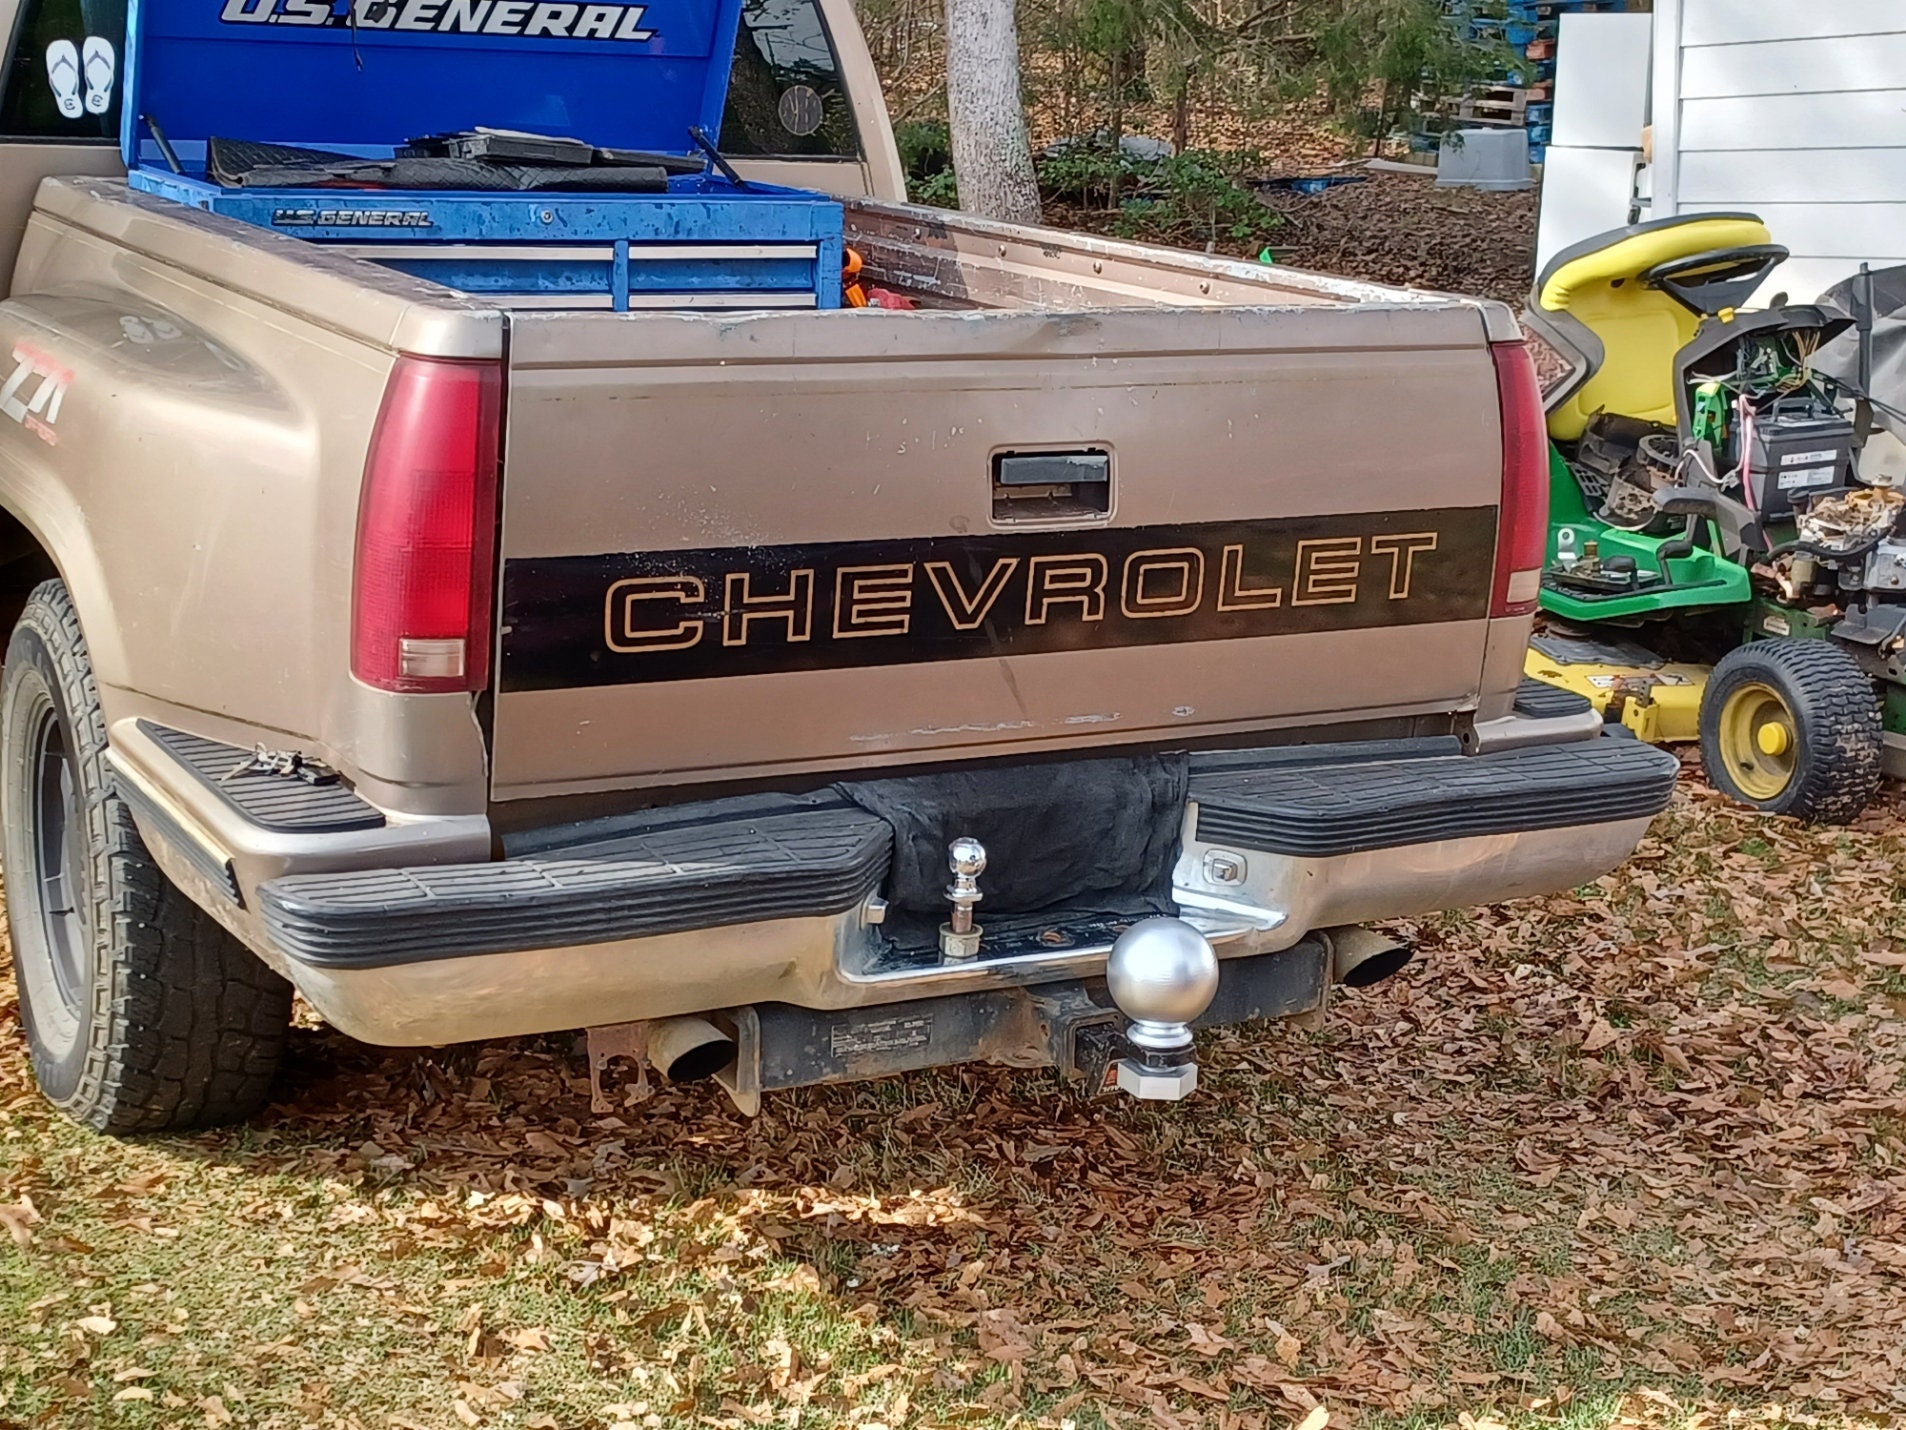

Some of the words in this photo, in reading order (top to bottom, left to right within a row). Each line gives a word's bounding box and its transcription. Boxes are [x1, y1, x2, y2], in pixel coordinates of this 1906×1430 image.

[221, 0, 334, 25] U.S.
[345, 0, 653, 40] GENERAL
[318, 210, 432, 226] GENERAL
[604, 532, 1438, 653] CHEVROLET
